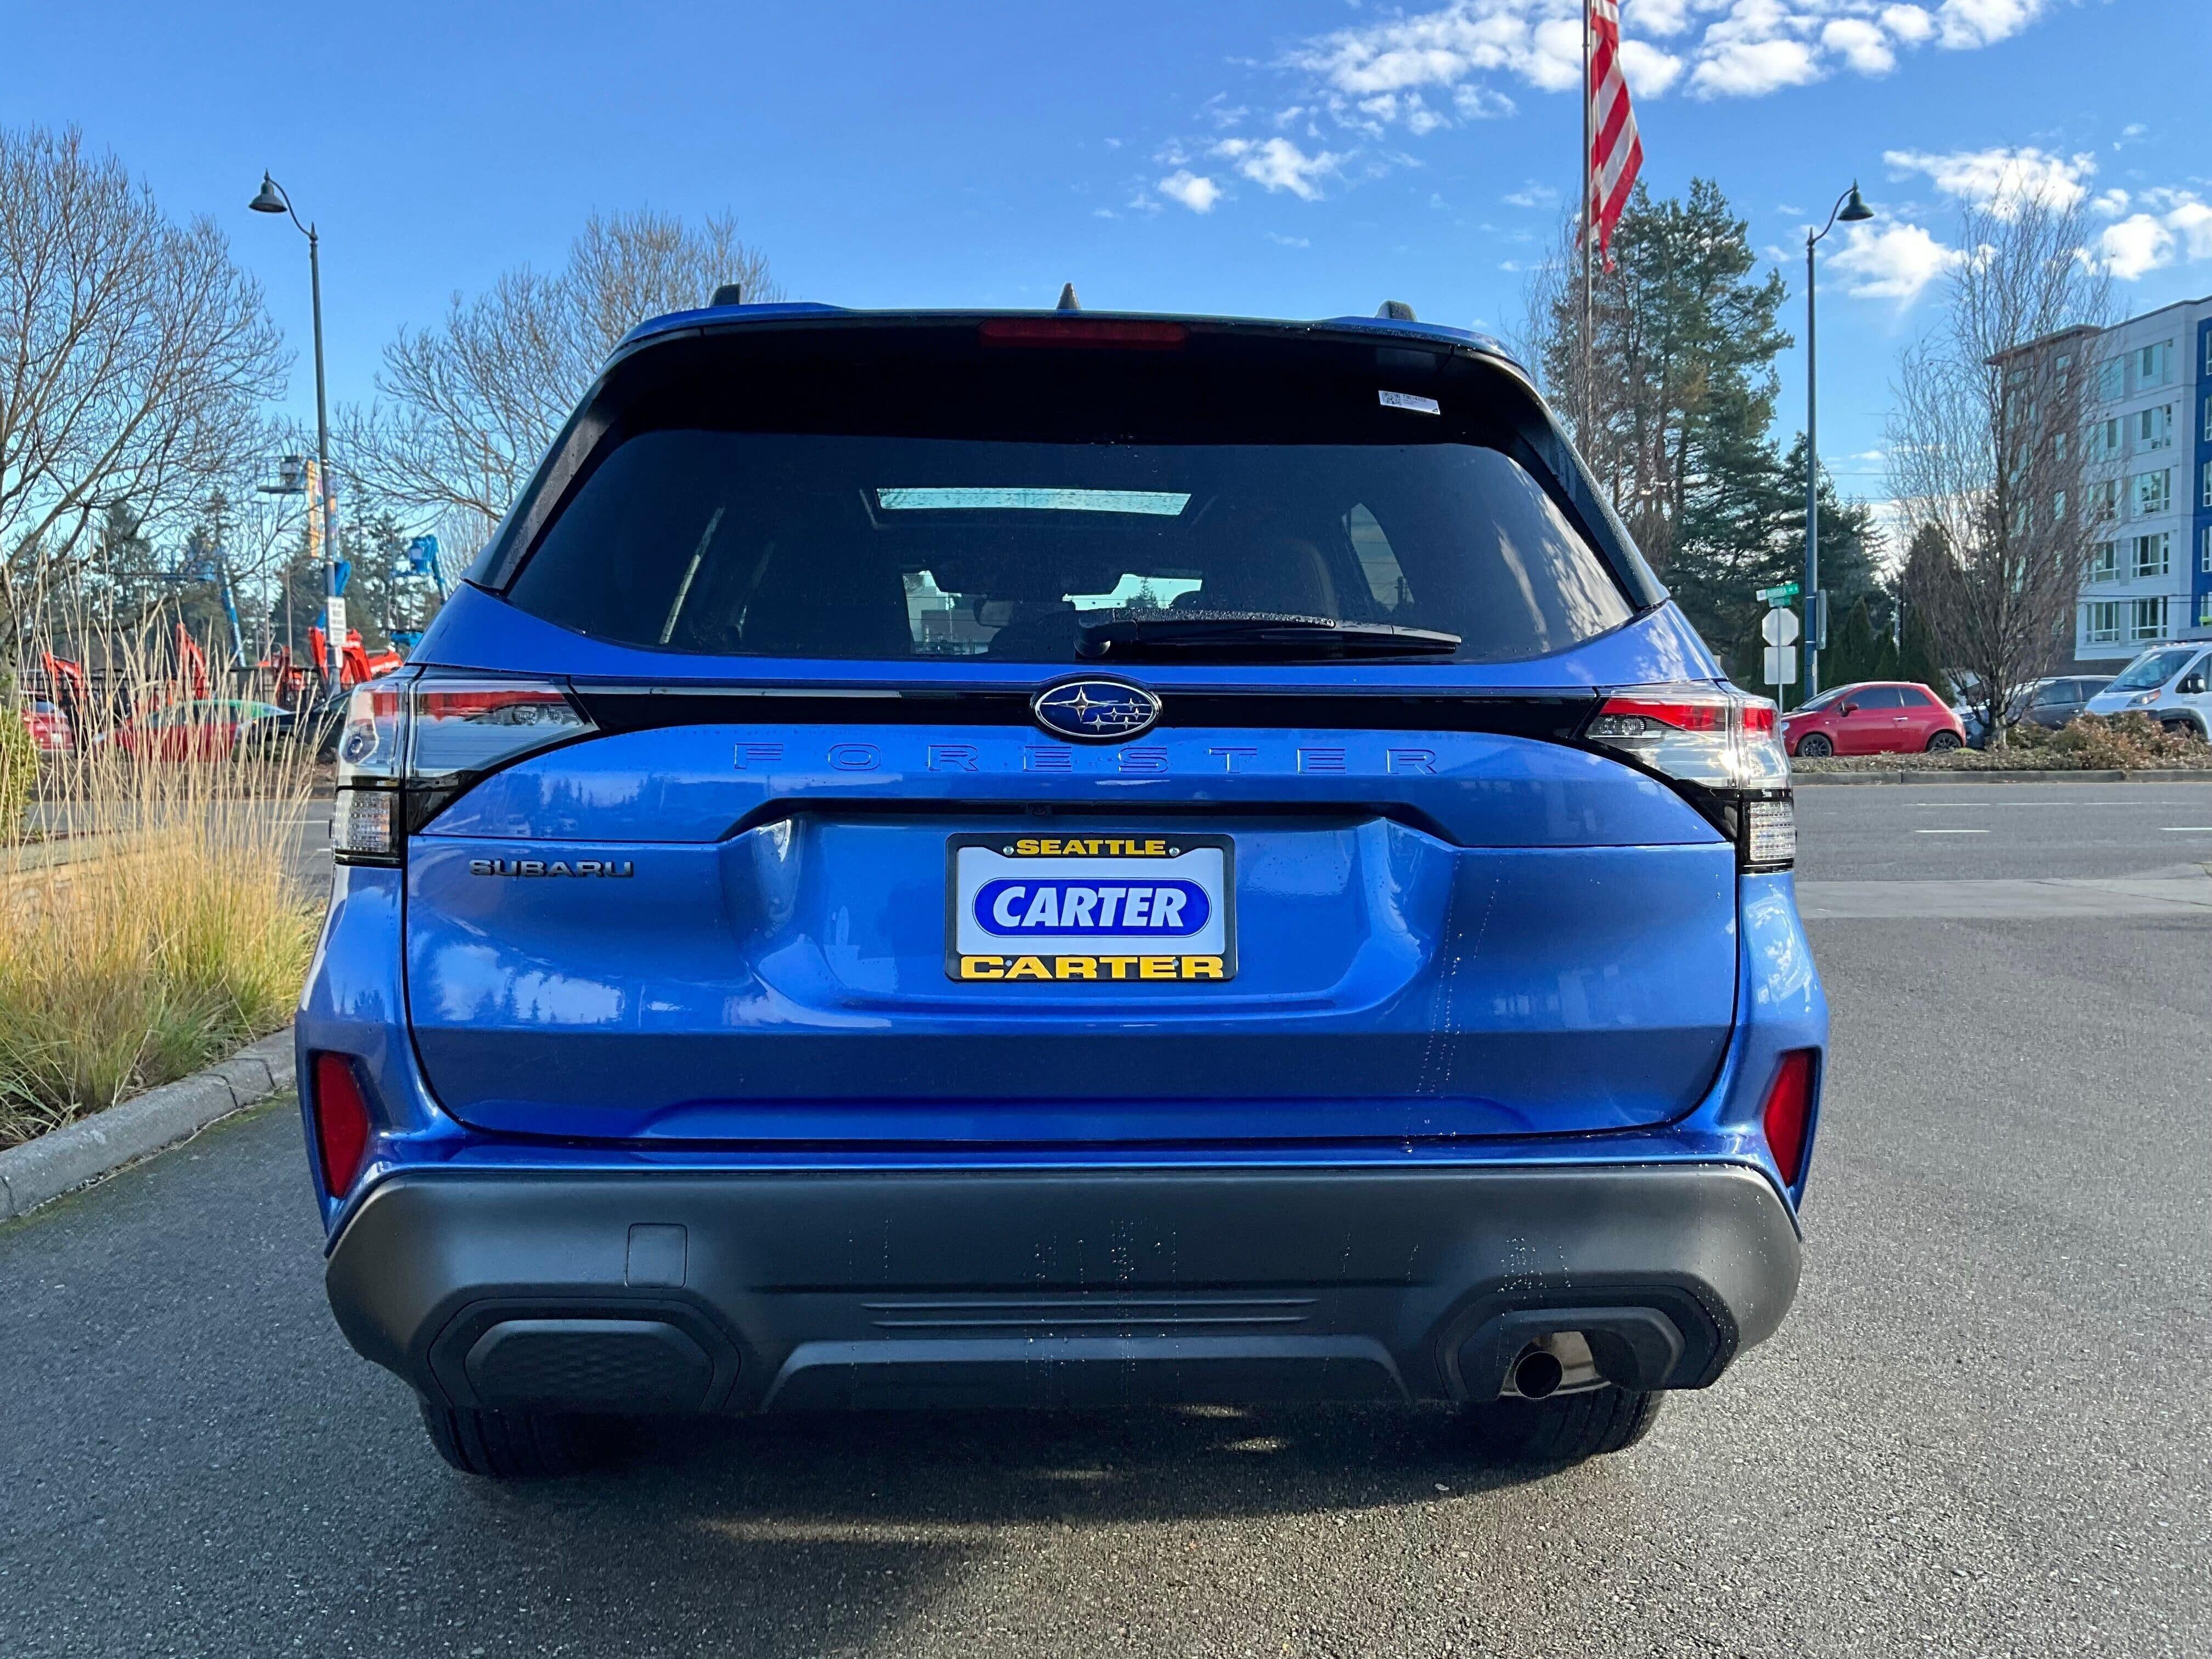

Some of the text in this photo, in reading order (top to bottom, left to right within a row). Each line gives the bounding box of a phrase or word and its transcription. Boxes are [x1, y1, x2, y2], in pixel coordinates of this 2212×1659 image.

[734, 743, 1437, 774] FORESTER
[1016, 839, 1166, 855] SEATTLE
[469, 859, 633, 878] SUBARU
[993, 887, 1187, 927] CARTER
[960, 956, 1223, 979] CARTER
